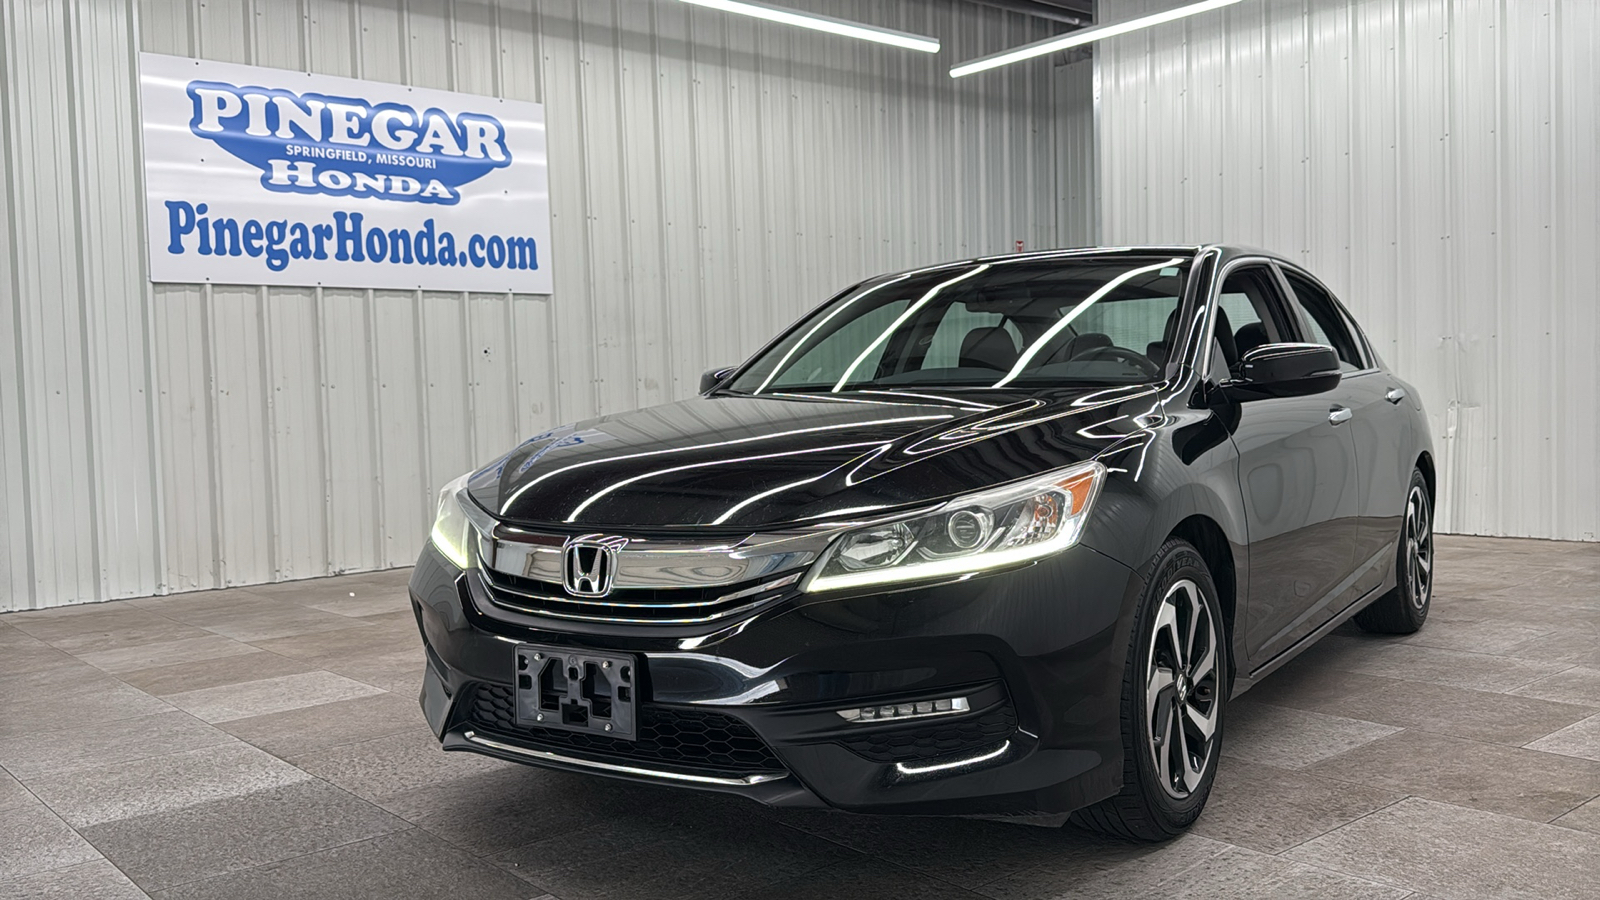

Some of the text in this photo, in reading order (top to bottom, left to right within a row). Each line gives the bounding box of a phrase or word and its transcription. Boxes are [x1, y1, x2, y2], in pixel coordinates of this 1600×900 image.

[193, 86, 507, 162] PINEGAR
[267, 158, 454, 199] HONDA
[285, 144, 437, 169] SPRINGFIELD, MISSOURI
[165, 200, 539, 272] PinegarHonda.com
